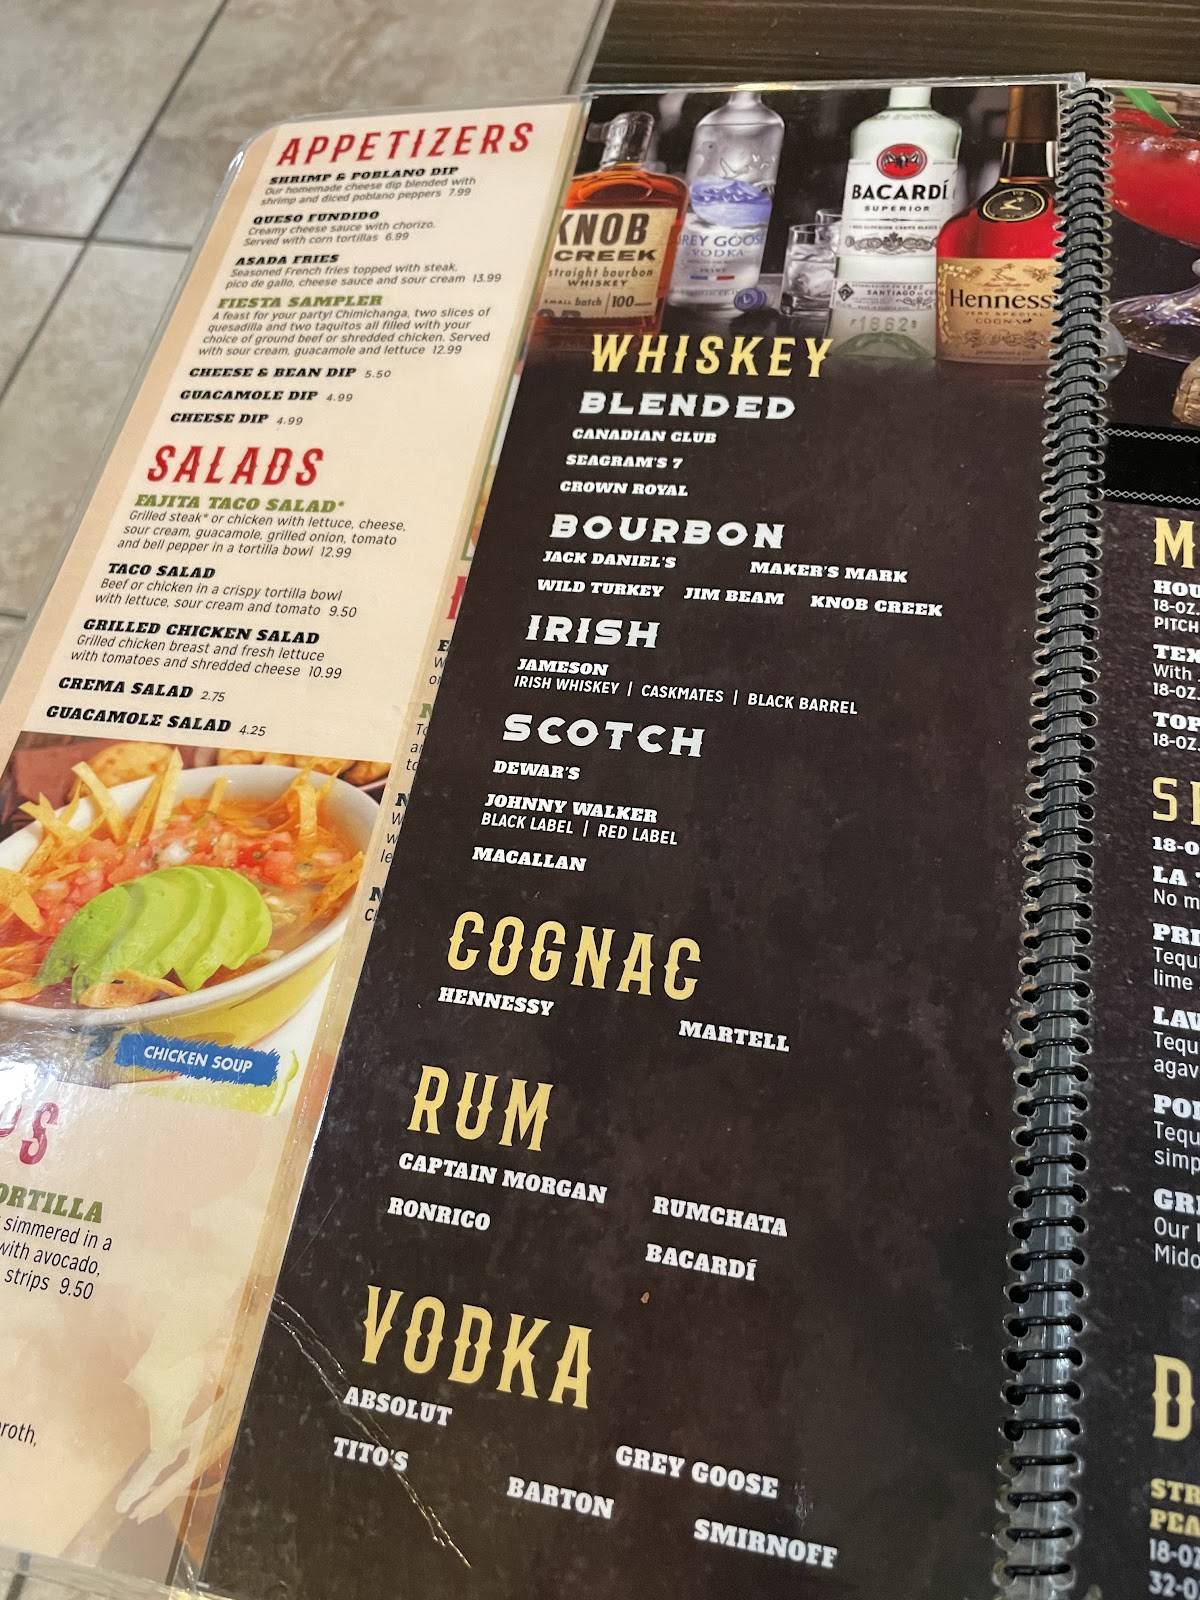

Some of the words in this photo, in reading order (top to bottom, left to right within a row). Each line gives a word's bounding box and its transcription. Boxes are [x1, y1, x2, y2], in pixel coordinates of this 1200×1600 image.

[276, 122, 533, 166] APPETIZERS
[269, 173, 332, 184] SHRIMP
[335, 172, 345, 181] &
[350, 168, 425, 180] POBLANO
[430, 166, 458, 176] DIP
[852, 180, 950, 200] BACARDÍ
[253, 214, 303, 225] QUESO
[307, 210, 379, 222] FUNDIDO
[235, 256, 286, 265] ASADA
[292, 254, 339, 264] FRIES
[554, 249, 656, 262] CREEK
[548, 266, 598, 279] straight
[602, 265, 653, 277] bourbon
[567, 279, 628, 287] WHISKEY
[217, 297, 281, 308] FIESTA
[287, 295, 382, 307] SAMPLER
[612, 295, 635, 308] 100
[198, 346, 223, 355] with
[226, 347, 251, 355] sour
[294, 345, 356, 356] guacamole
[358, 345, 381, 355] and
[383, 345, 425, 355] lettuce
[432, 345, 462, 354] 12.99
[591, 333, 833, 377] WHISKEY
[189, 367, 252, 378] CHEESE
[257, 367, 269, 378] &
[273, 367, 323, 378] BEAN
[326, 367, 357, 378] DIP
[364, 369, 391, 379] 5.50
[180, 390, 283, 400] GUACAMOLE
[287, 390, 318, 400] DIP
[326, 393, 352, 401] 4.99
[579, 391, 795, 419] BLENDED
[170, 413, 235, 424] CHEESE
[239, 413, 269, 424] DIP
[276, 416, 303, 426] 4.99
[572, 428, 666, 441] CANADIAN
[670, 431, 716, 443] CLUB
[147, 445, 323, 486] SALADS
[565, 454, 667, 468] SEAGRAM'S
[672, 457, 683, 469] 7
[559, 480, 628, 493] CROWN
[631, 483, 688, 496] ROYAL
[134, 494, 200, 508] FAJITA
[208, 496, 260, 510] TACO
[129, 510, 167, 521] Grilled
[211, 514, 224, 523] or
[226, 513, 273, 525] chicken
[277, 515, 304, 526] with
[549, 513, 784, 549] BOURBON
[108, 563, 152, 575] TACO
[156, 565, 215, 578] SALAD
[542, 550, 587, 563] JACK
[590, 552, 676, 568] DANIEL'S
[749, 561, 839, 578] MAKER'S
[844, 567, 907, 583] MARK
[537, 579, 585, 592] WILD
[590, 581, 664, 597] TURKEY
[683, 587, 720, 600] JIM
[724, 589, 785, 604] BEAM
[810, 595, 868, 610] KNOB
[874, 599, 942, 616] CREEK
[83, 618, 160, 634] GRILLED
[165, 623, 252, 640] CHICKEN
[256, 629, 319, 644] SALAD
[525, 614, 660, 648] IRISH
[77, 634, 116, 647] Grilled
[118, 637, 165, 651] chicken
[168, 639, 210, 654] breast
[213, 643, 238, 655] and
[241, 644, 274, 658] fresh
[278, 646, 324, 661] lettuce
[71, 650, 98, 662] with
[101, 651, 160, 666] tomatoes
[163, 656, 188, 668] and
[190, 657, 251, 672] shredded
[254, 662, 300, 676] cheese
[308, 665, 342, 679] 10.99
[516, 658, 609, 676] JAMESON
[1153, 663, 1192, 681] With
[58, 676, 125, 693] CREMA
[130, 682, 193, 698] SALAD
[200, 690, 225, 702] 2.75
[513, 674, 551, 689] IRISH
[556, 677, 620, 694] WHISKEY
[641, 684, 723, 702] CASKMATES
[747, 692, 794, 709] BLACK
[798, 697, 857, 714] BARREL
[46, 705, 163, 727] GUACAMOLE
[166, 715, 231, 732] SALAD
[239, 724, 266, 736] 4.25
[502, 713, 705, 757] SCOTCH
[492, 760, 580, 780] DEWAR'S
[484, 793, 567, 813] JOHNNY
[572, 801, 657, 823] WALKER
[480, 811, 527, 829] BLACK
[529, 816, 573, 834] LABEL
[597, 823, 627, 839] RED
[632, 827, 677, 845] LABEL
[471, 846, 586, 871] MACALLAN
[1152, 865, 1188, 887] LA
[1153, 888, 1178, 906] No
[447, 912, 700, 1000] COGNAC
[1153, 968, 1193, 991] lime
[437, 986, 554, 1016] HENNESSY
[678, 1019, 789, 1052] MARTELL
[143, 1045, 208, 1067] CHICKEN
[211, 1055, 252, 1073] SOUP
[1153, 1058, 1200, 1080] agav
[406, 1065, 553, 1151] RUM
[398, 1152, 497, 1184] CAPTAIN
[501, 1169, 607, 1204] MORGAN
[387, 1196, 490, 1230] RONRICO
[652, 1195, 787, 1237] RUMCHATA
[3, 1217, 80, 1244] simmered
[82, 1229, 98, 1248] in
[102, 1237, 112, 1251] a
[1153, 1216, 1190, 1240] Our
[33, 1248, 101, 1277] avocado,
[645, 1243, 757, 1281] BACARDÍ
[4, 1269, 50, 1291] strips
[59, 1277, 93, 1299] 9.50
[361, 1284, 592, 1409] VODKA
[342, 1386, 452, 1426] ABSOLUT
[0, 1421, 37, 1448] roth,
[333, 1436, 408, 1471] TITO'S
[615, 1445, 685, 1478] GREY
[691, 1461, 778, 1498] GOOSE
[506, 1476, 614, 1519] BARTON
[693, 1518, 837, 1568] SMIRNOFF
